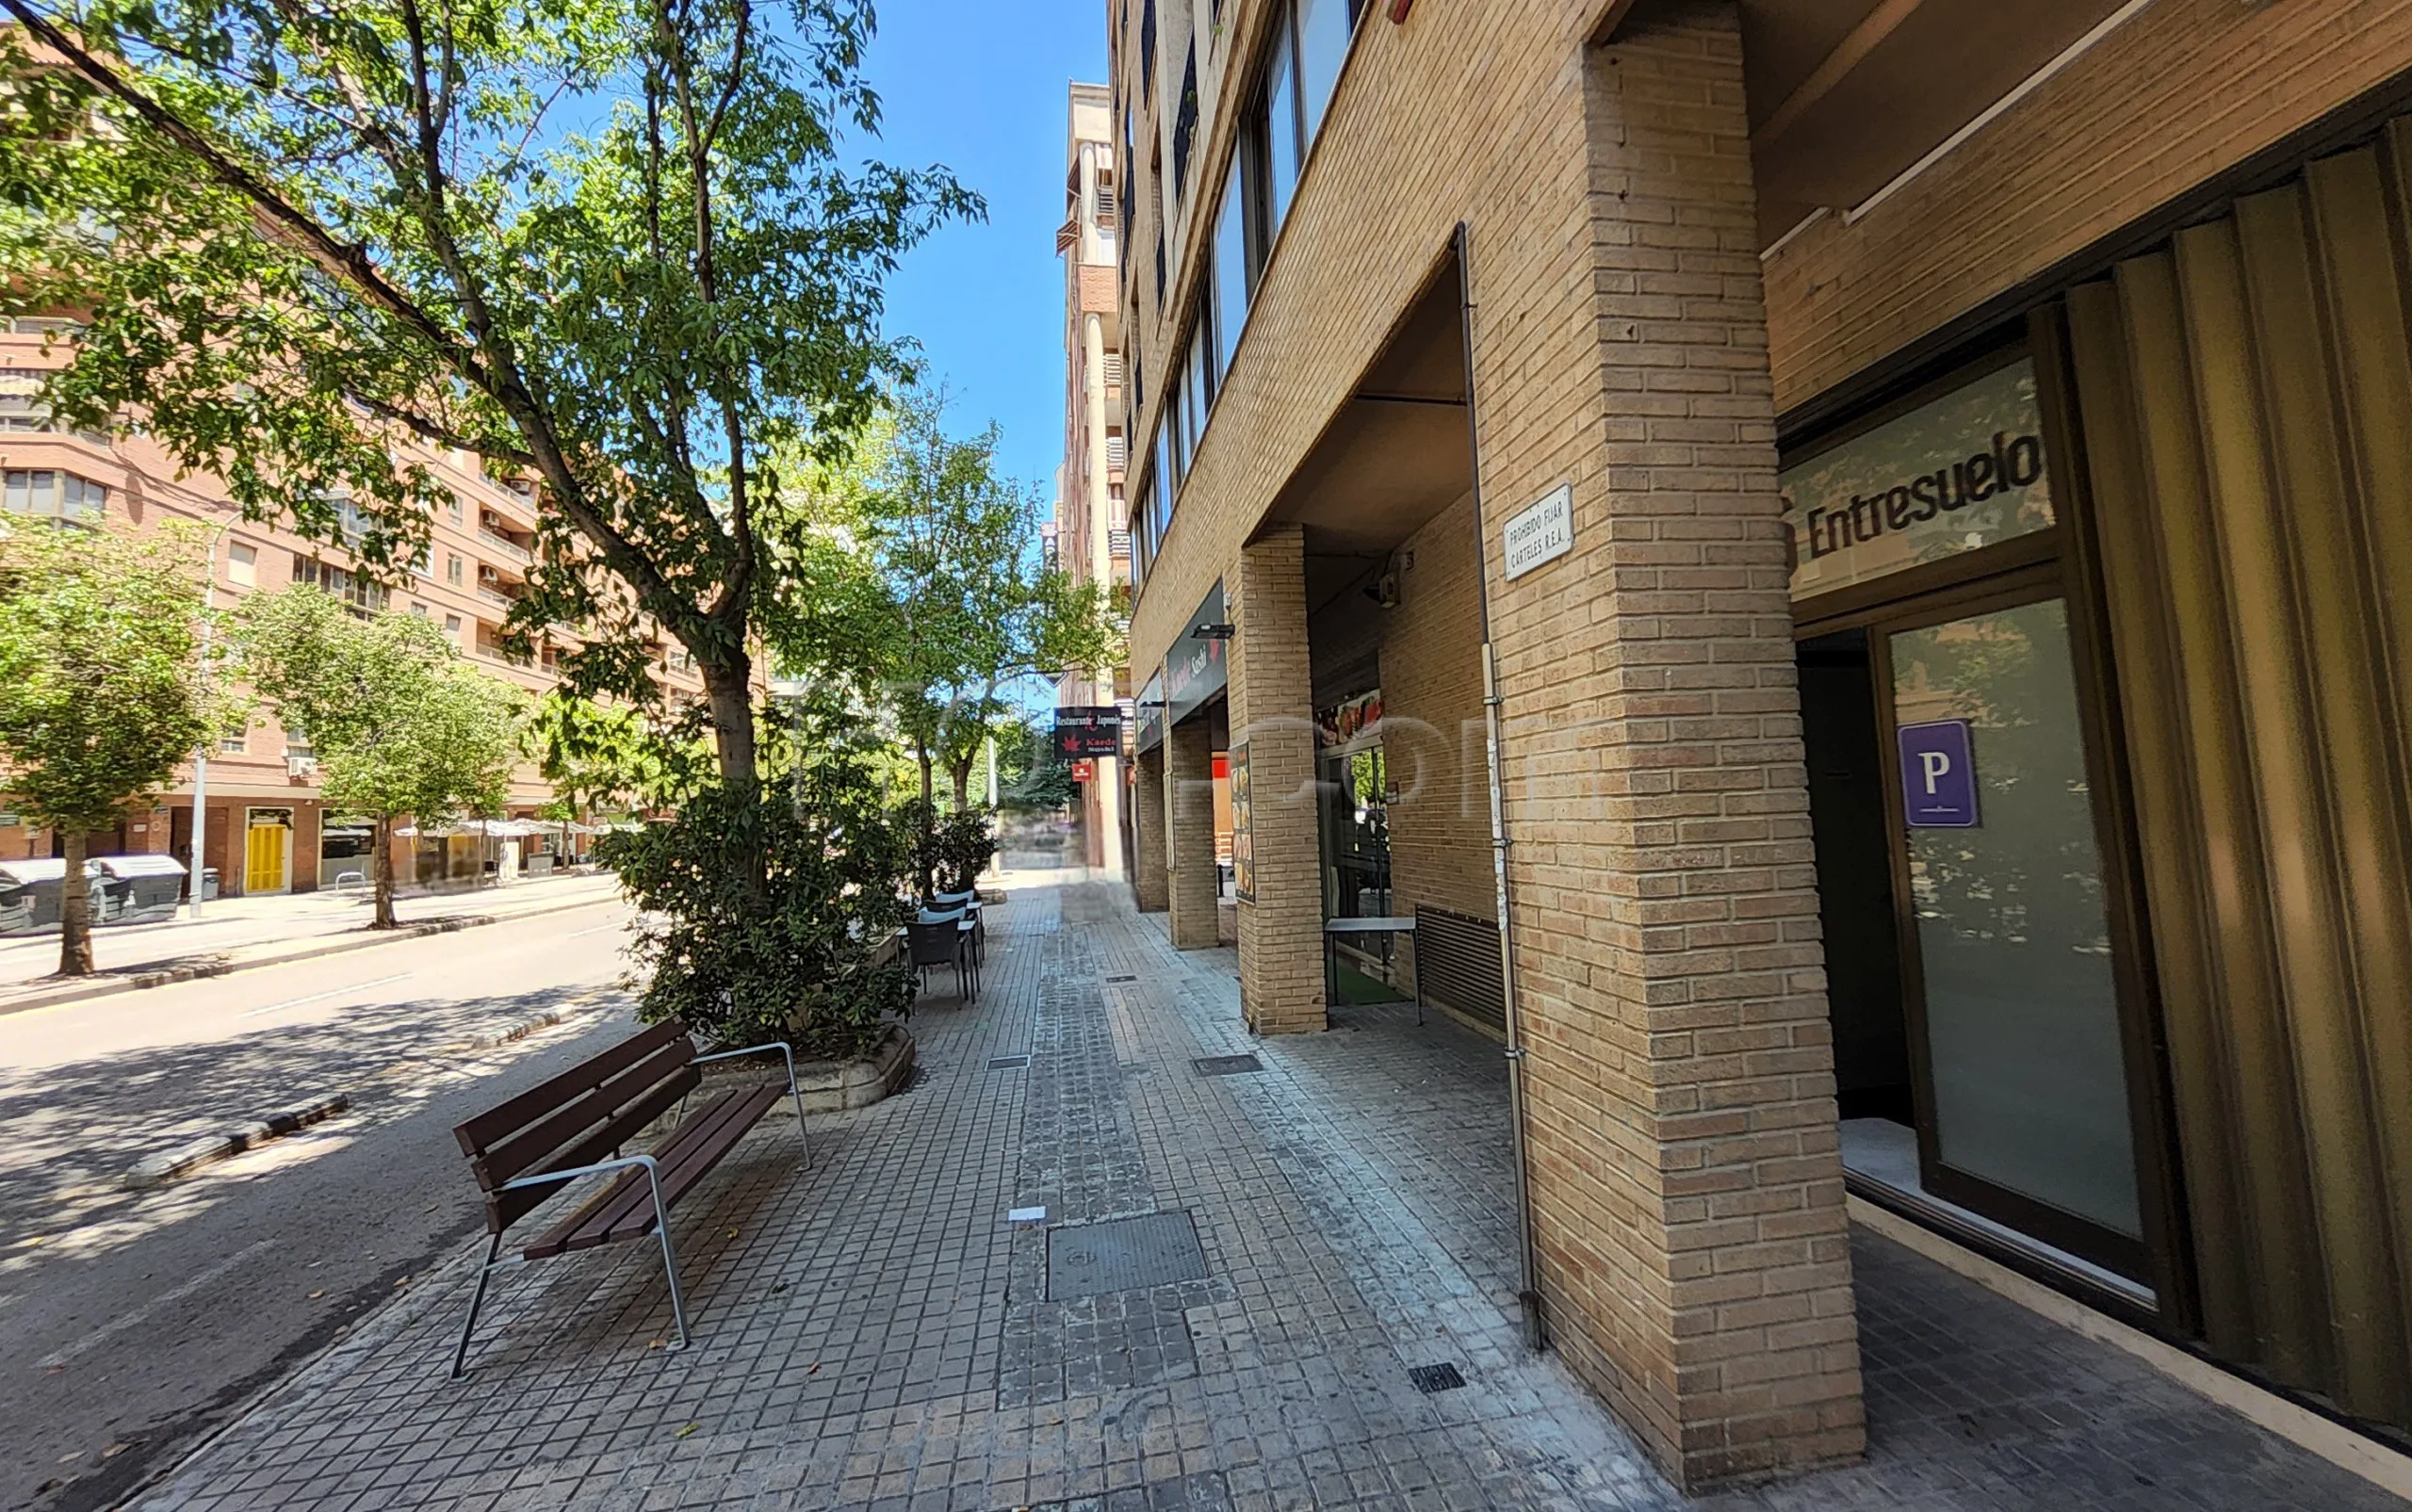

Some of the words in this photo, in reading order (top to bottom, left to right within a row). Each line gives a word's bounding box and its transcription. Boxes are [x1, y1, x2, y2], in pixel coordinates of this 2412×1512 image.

[1806, 431, 2043, 560] Entresuelo
[1509, 514, 1542, 546] PROHIBIDO
[1543, 500, 1564, 527] FIJAR
[1510, 538, 1542, 569] CARTELES
[1056, 716, 1093, 726] Restaurante
[1097, 713, 1121, 727] Japonés
[1085, 738, 1116, 746] Kaede
[1917, 751, 1950, 794] P
